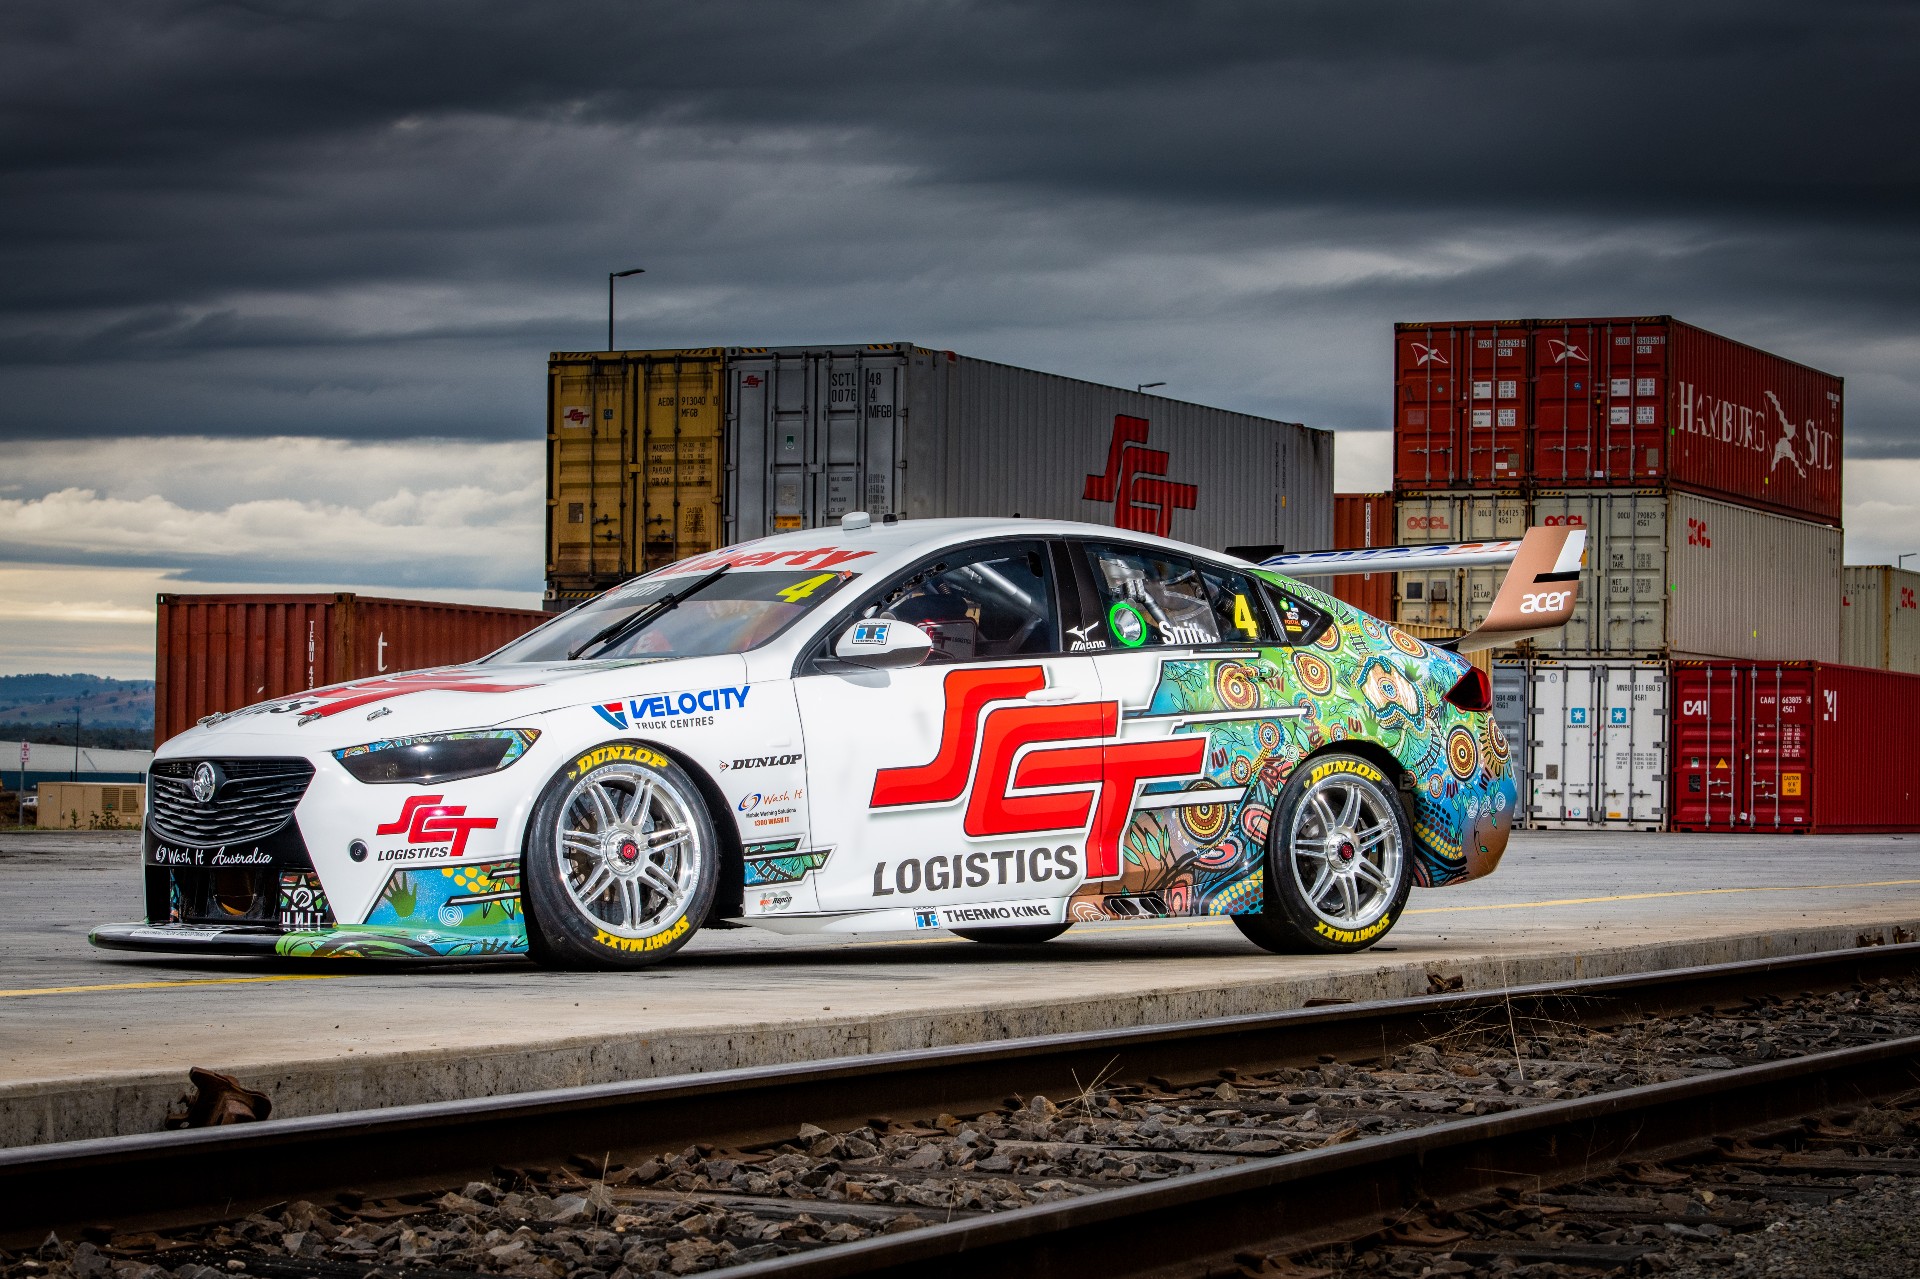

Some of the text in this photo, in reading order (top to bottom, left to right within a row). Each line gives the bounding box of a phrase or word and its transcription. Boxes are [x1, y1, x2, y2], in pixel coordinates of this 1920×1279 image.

[832, 373, 881, 386] SCTL 48
[681, 397, 706, 406] 913040
[832, 389, 876, 402] 0076 4
[564, 409, 590, 424] SCT
[681, 408, 698, 417] MFGB
[869, 405, 892, 418] MFGB
[1679, 381, 1765, 452] HAMBURG
[1082, 414, 1198, 537] SCT
[776, 573, 837, 603] 4
[1520, 590, 1572, 614] acer
[1234, 594, 1258, 638] 4
[630, 685, 751, 719] VELOCITY
[1683, 700, 1707, 715] CAI
[635, 715, 715, 730] TRUCK CENTRES
[577, 746, 669, 776] DUNLOP
[731, 754, 802, 770] DUNLOP
[869, 665, 1207, 879] SCT
[1310, 760, 1382, 784] DUNLOP
[376, 794, 499, 857] SCT
[169, 849, 192, 865] Wash
[211, 846, 273, 865] Australia
[378, 846, 449, 861] LOGISTICS
[872, 844, 1079, 897] LOGISTICS
[943, 905, 1051, 923] THERMO KING
